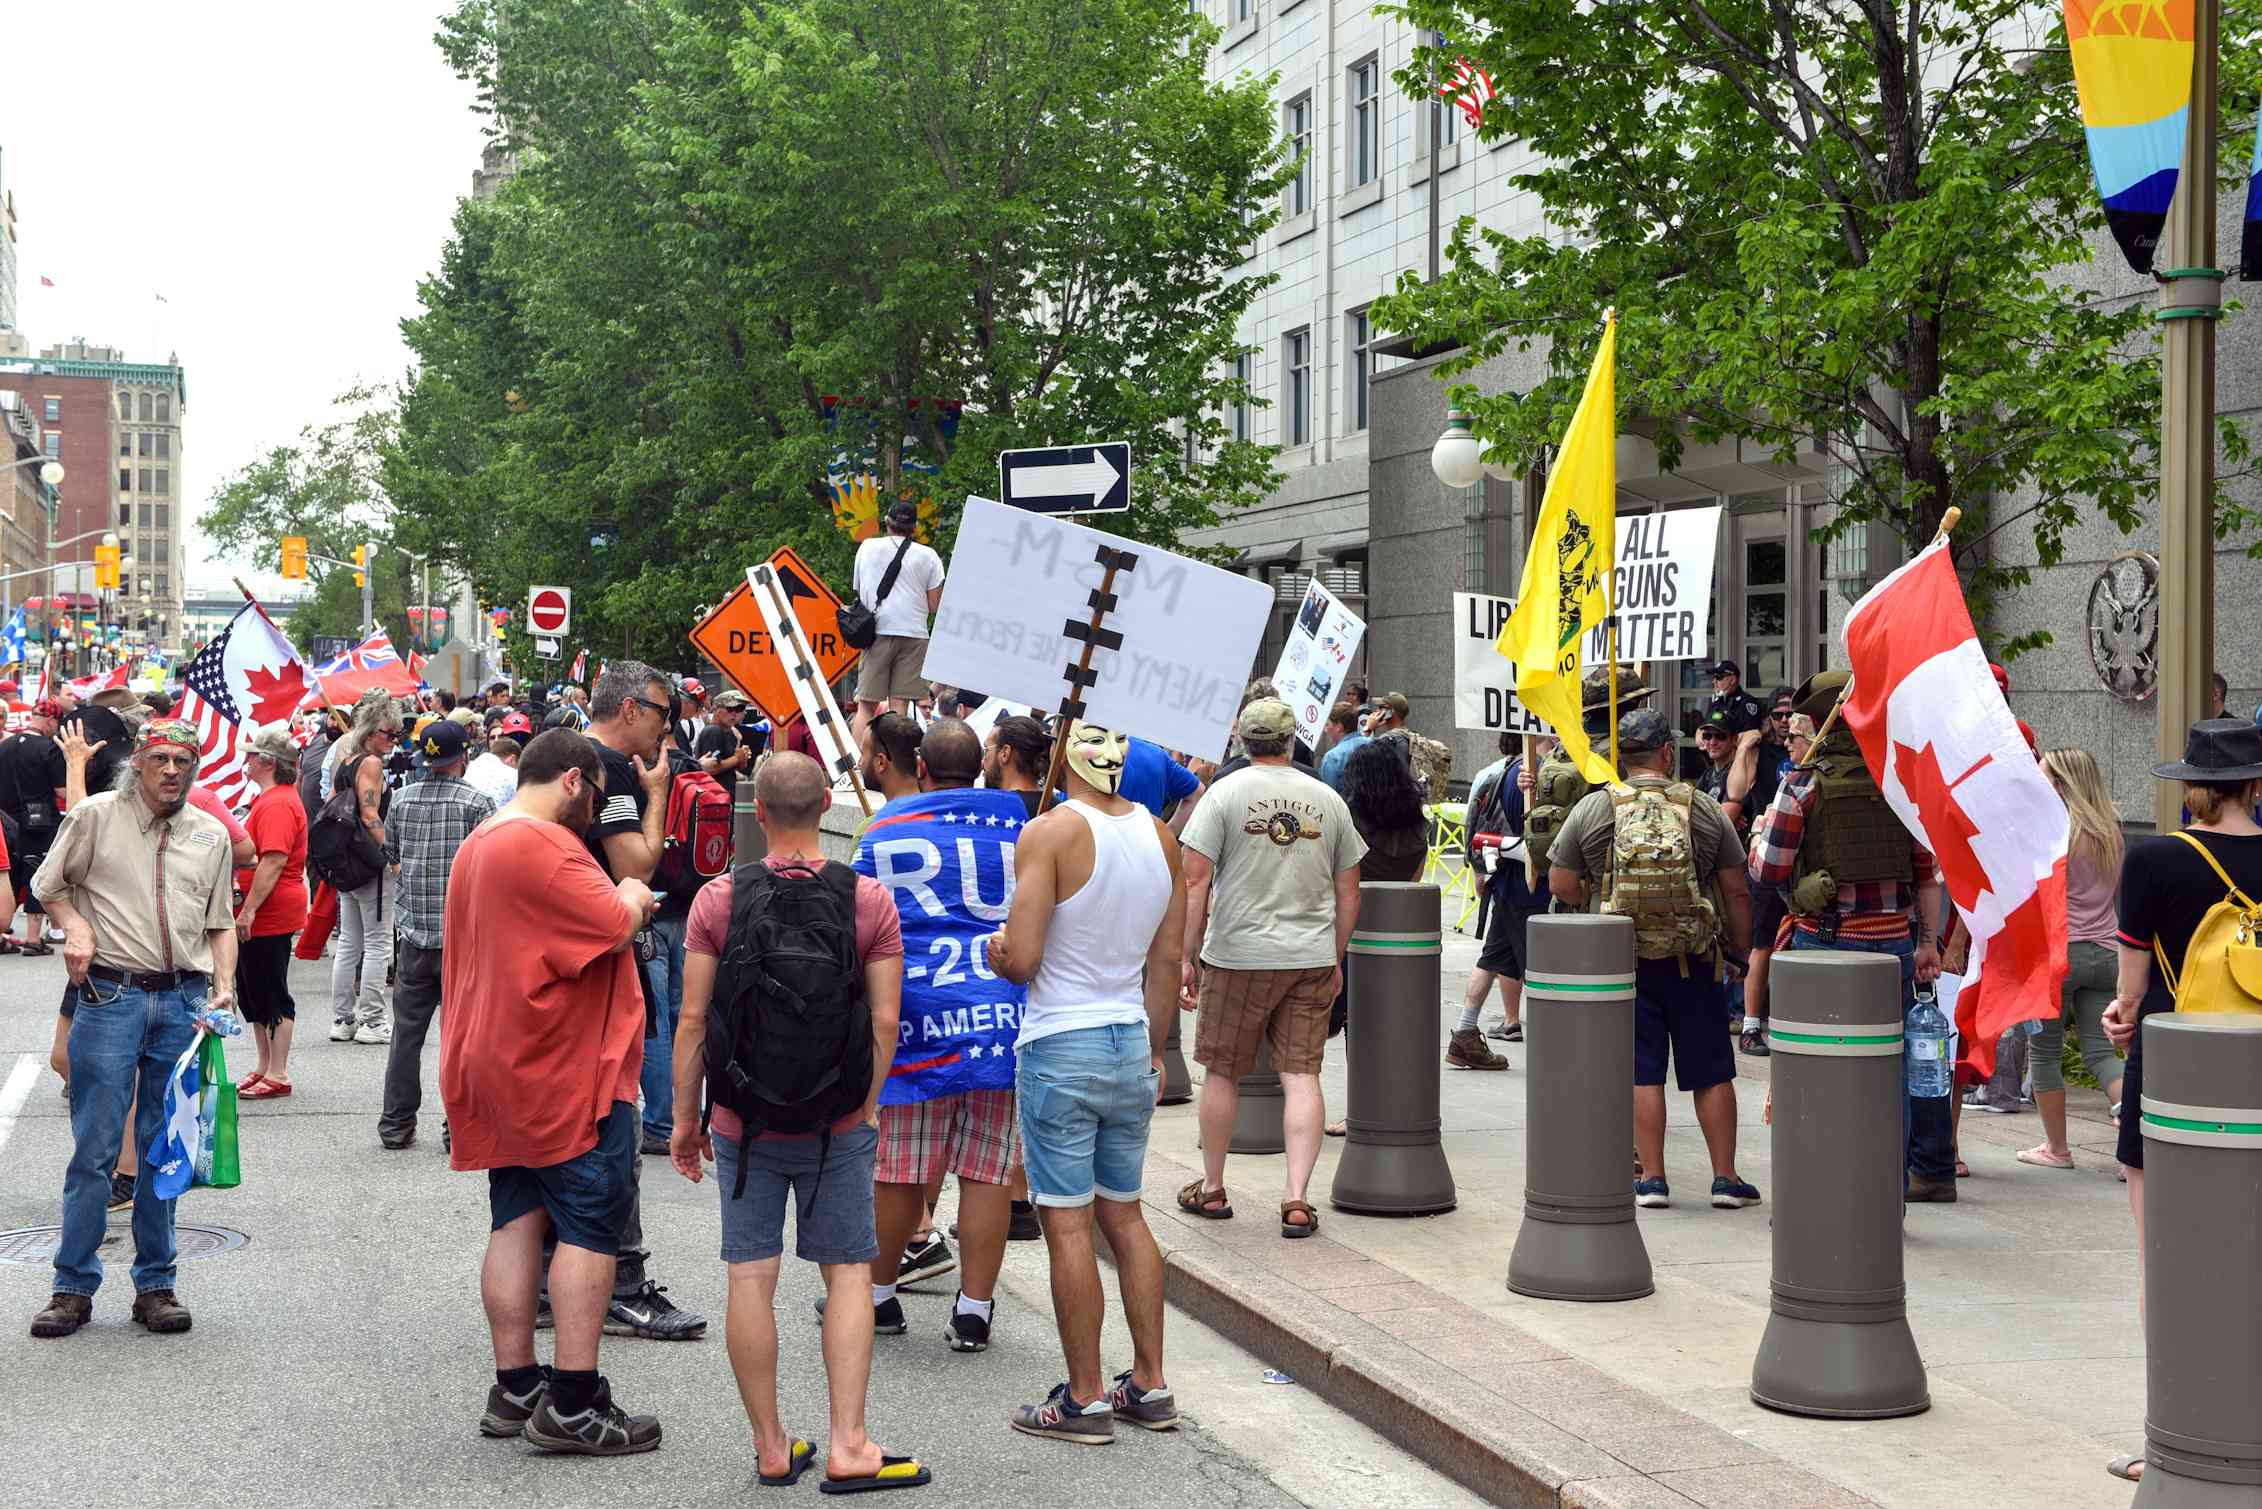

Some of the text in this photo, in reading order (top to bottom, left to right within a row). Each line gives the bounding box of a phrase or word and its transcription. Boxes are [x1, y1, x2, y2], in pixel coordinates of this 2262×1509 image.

[1622, 514, 1669, 562] ALL
[1614, 562, 1679, 610] GUNS
[729, 630, 836, 656] DETUR
[1591, 611, 1695, 662] MATTER
[1484, 687, 1557, 733] DEA
[1247, 799, 1323, 824] ANTIGUA
[922, 1002, 1023, 1042] AMERI
